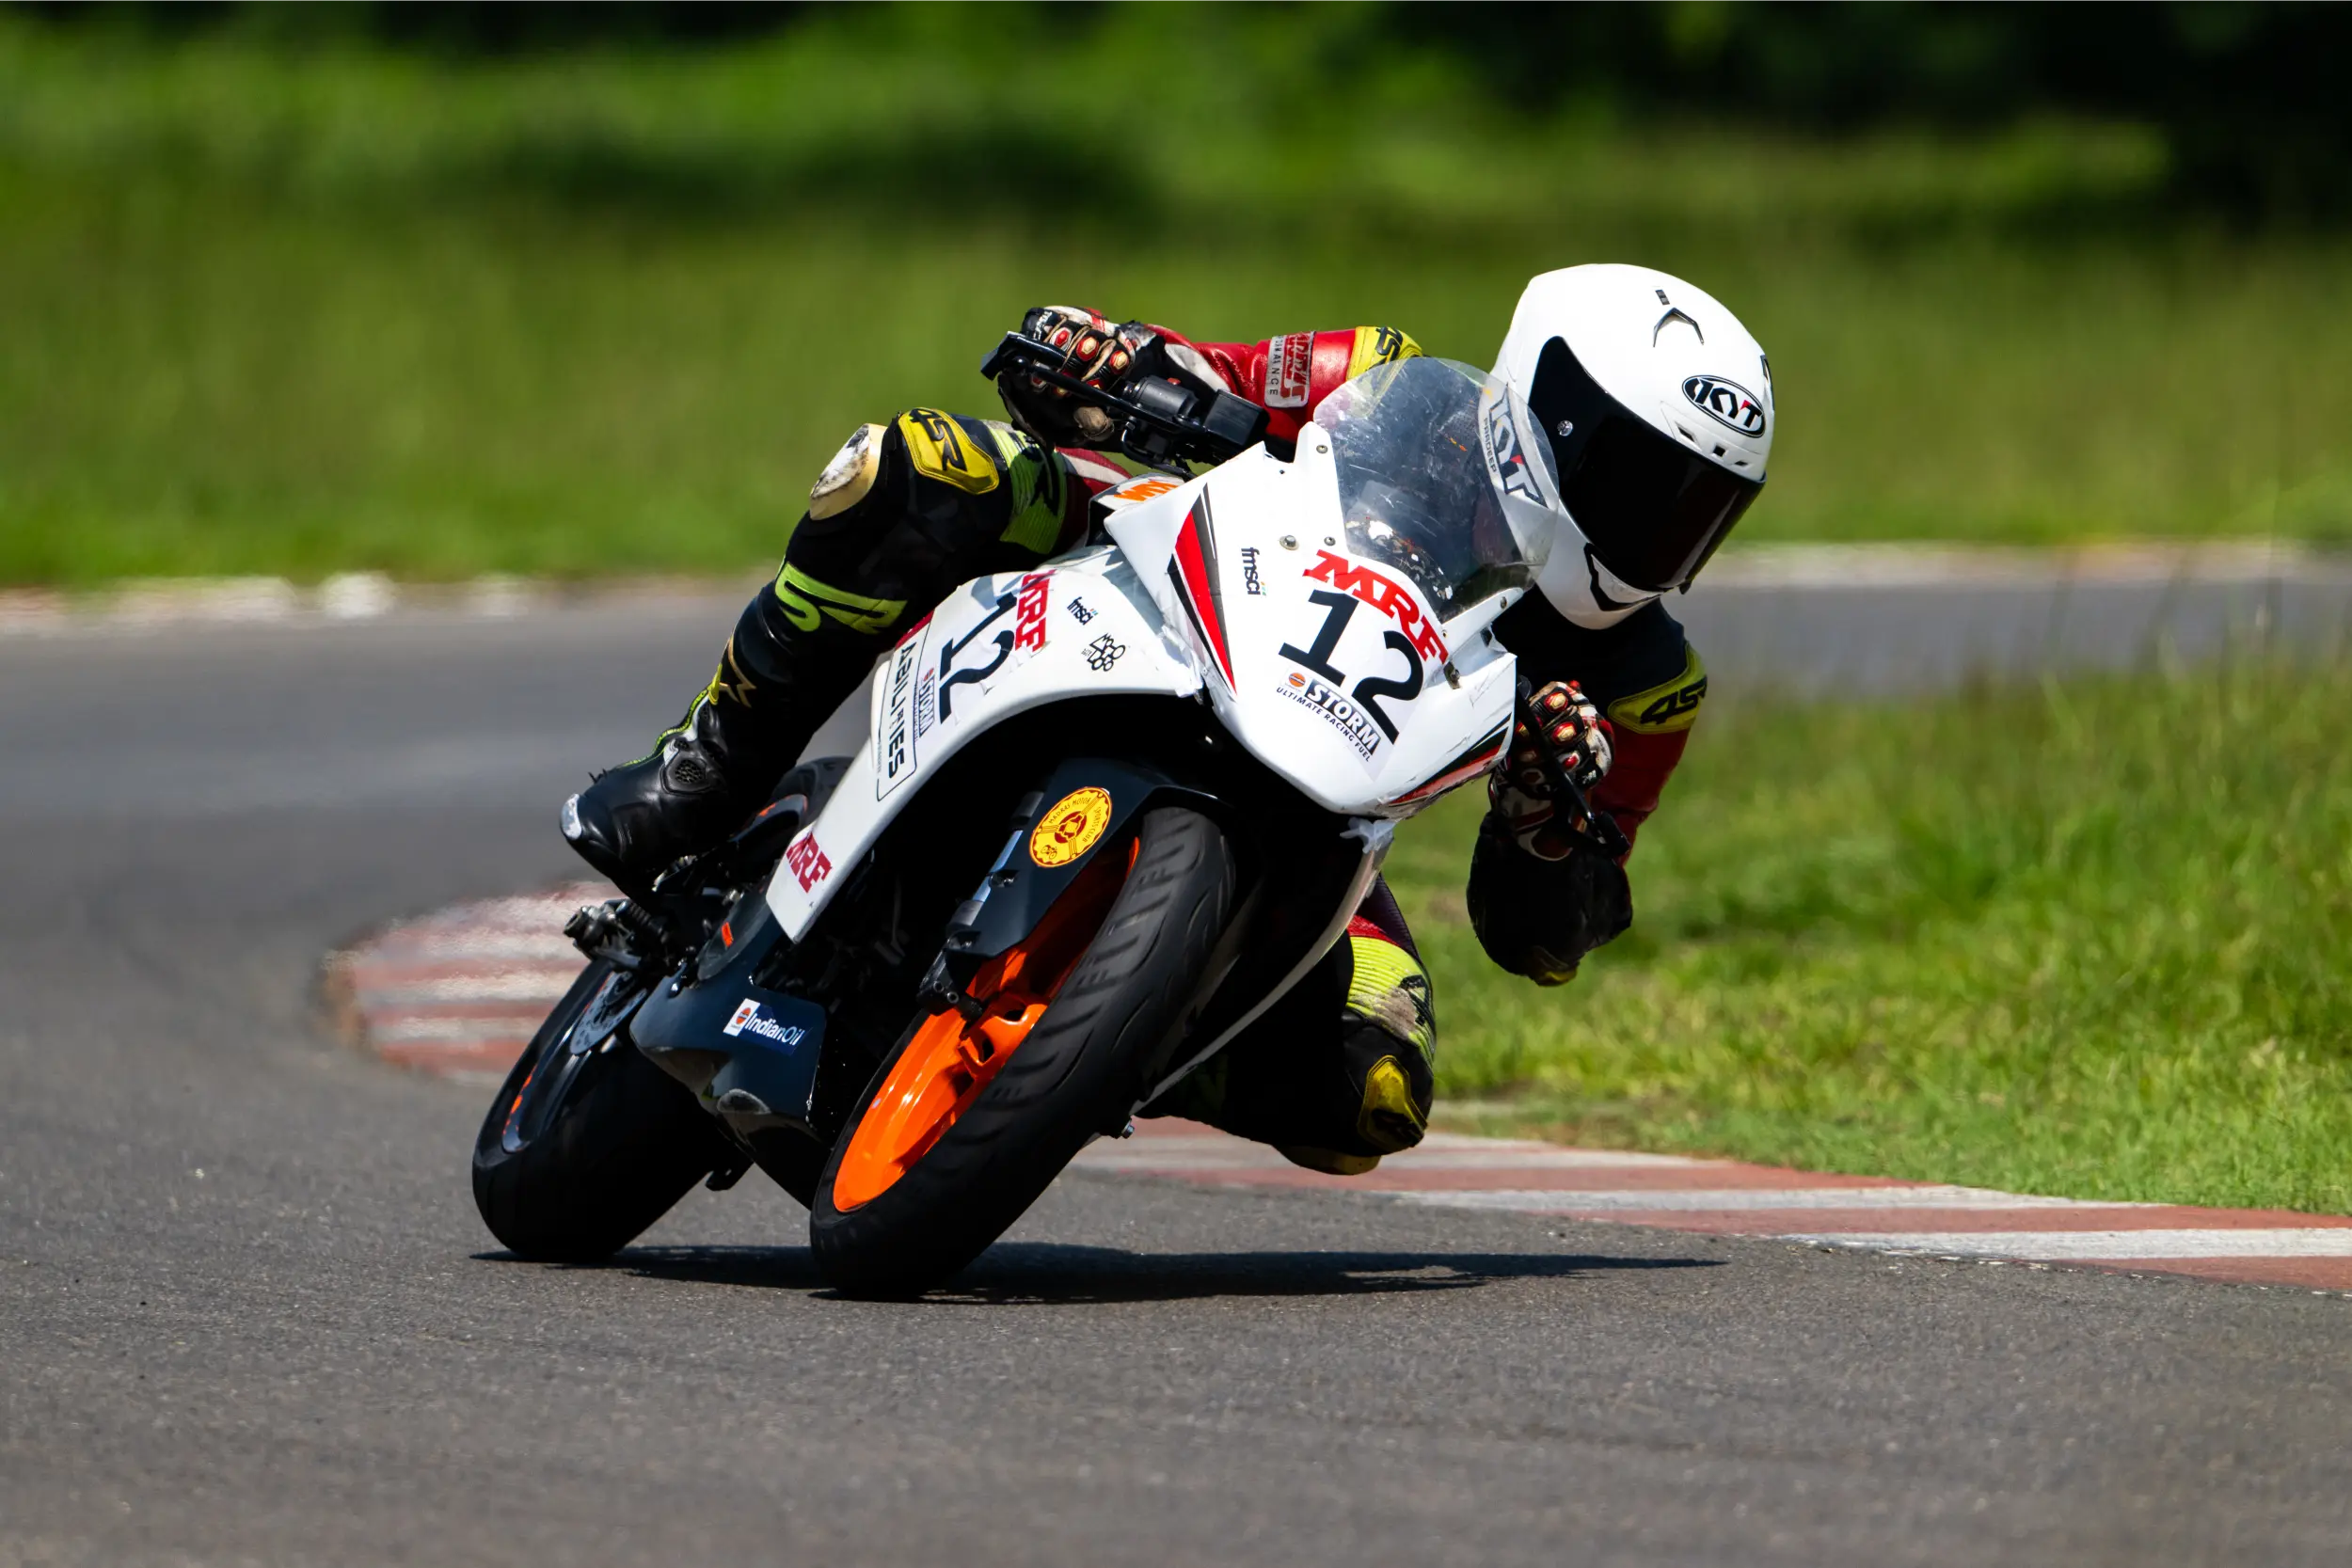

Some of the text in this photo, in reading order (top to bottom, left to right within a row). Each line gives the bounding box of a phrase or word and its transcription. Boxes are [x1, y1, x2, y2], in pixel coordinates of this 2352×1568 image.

[1692, 378, 1764, 429] KYT
[1015, 569, 1057, 652] MRF
[1302, 549, 1449, 664] MRF
[939, 592, 1017, 724] 12
[1278, 589, 1423, 744] 12
[1276, 687, 1372, 763] ULTIMATE RACING FUEL
[1306, 681, 1380, 752] STORM
[744, 1013, 805, 1046] IndianOil
